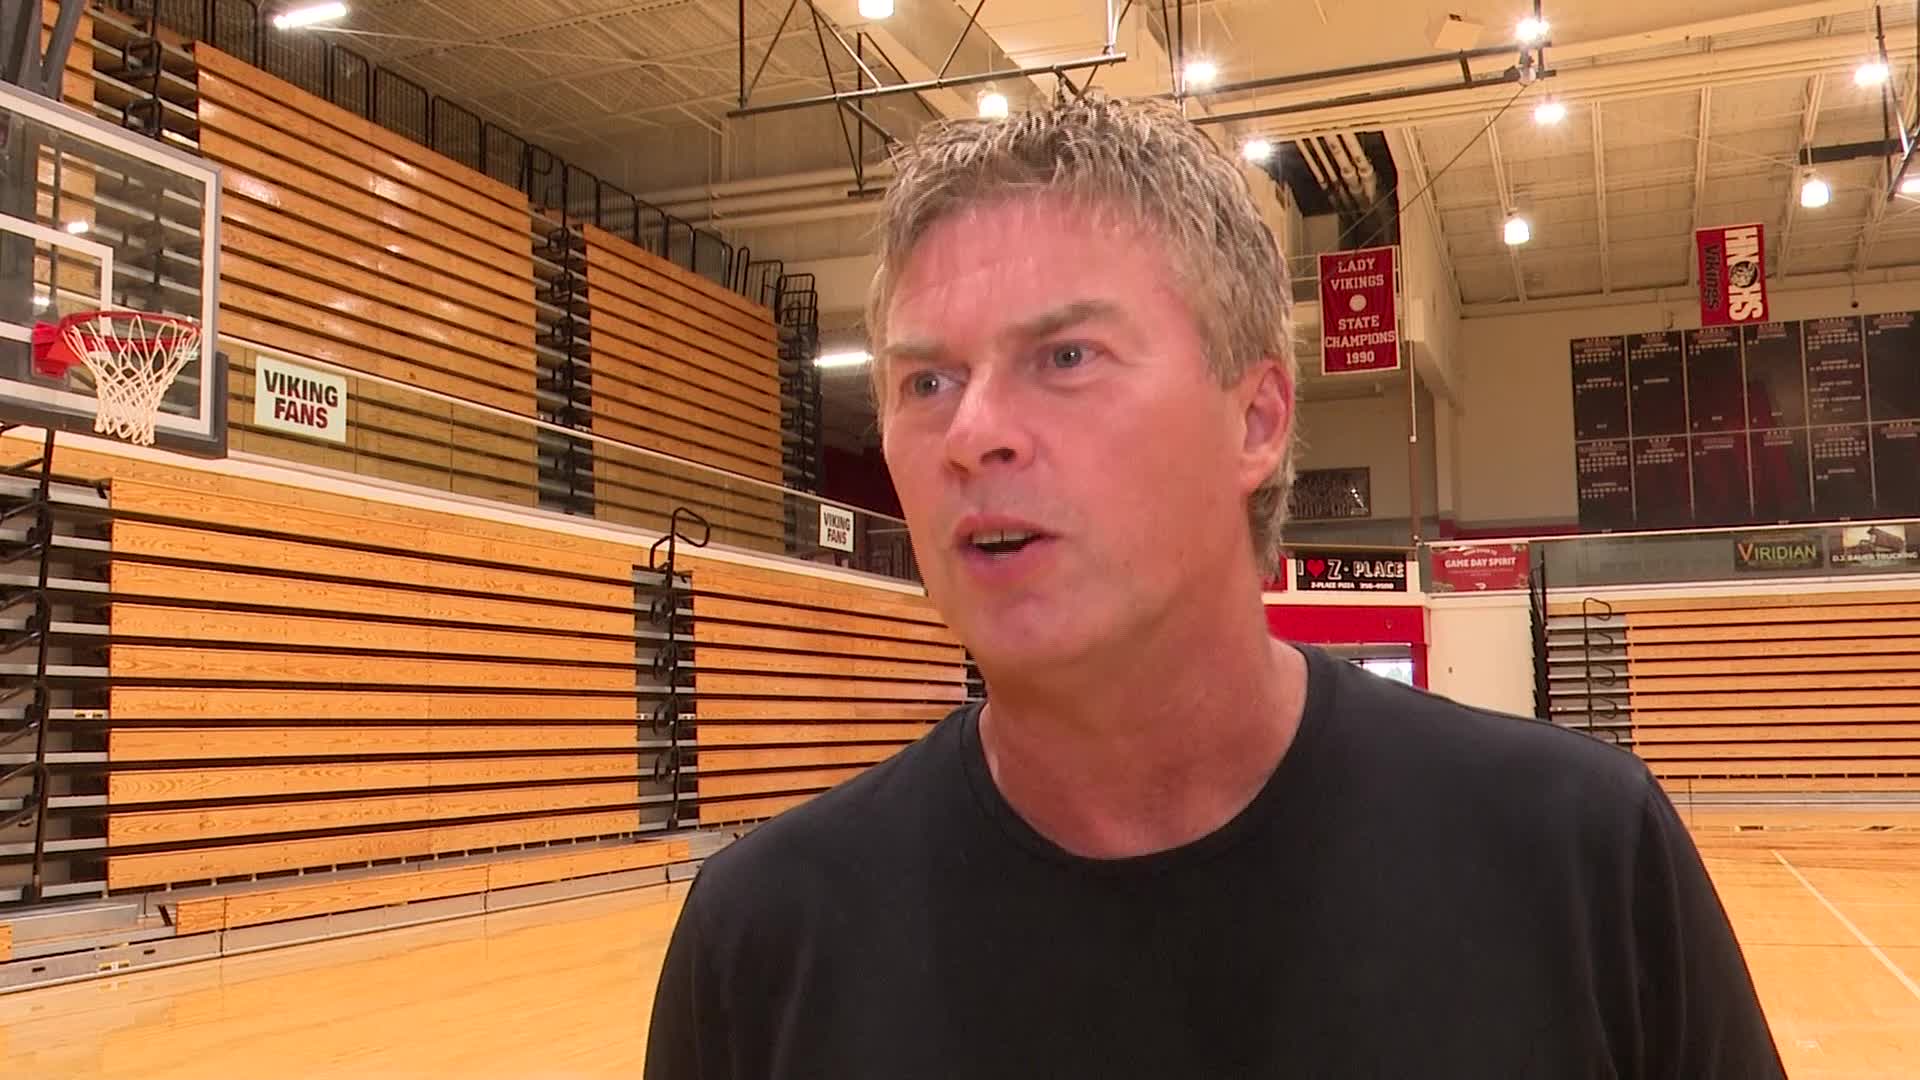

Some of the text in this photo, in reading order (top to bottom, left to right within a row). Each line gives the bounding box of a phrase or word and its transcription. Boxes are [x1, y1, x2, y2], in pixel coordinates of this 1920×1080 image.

[1338, 257, 1375, 273] LADY
[1330, 274, 1384, 291] VIKINGS
[1338, 315, 1380, 331] STATE
[1325, 331, 1396, 348] CHAMPIONS
[1346, 351, 1375, 365] 1990
[263, 369, 338, 408] VIKING
[274, 397, 328, 429] FANS
[823, 511, 850, 532] VIKING
[827, 528, 847, 545] FANS
[1297, 559, 1304, 576] I
[1353, 560, 1405, 578] PLACE
[1444, 557, 1517, 568] GAME DAY SPIRIT
